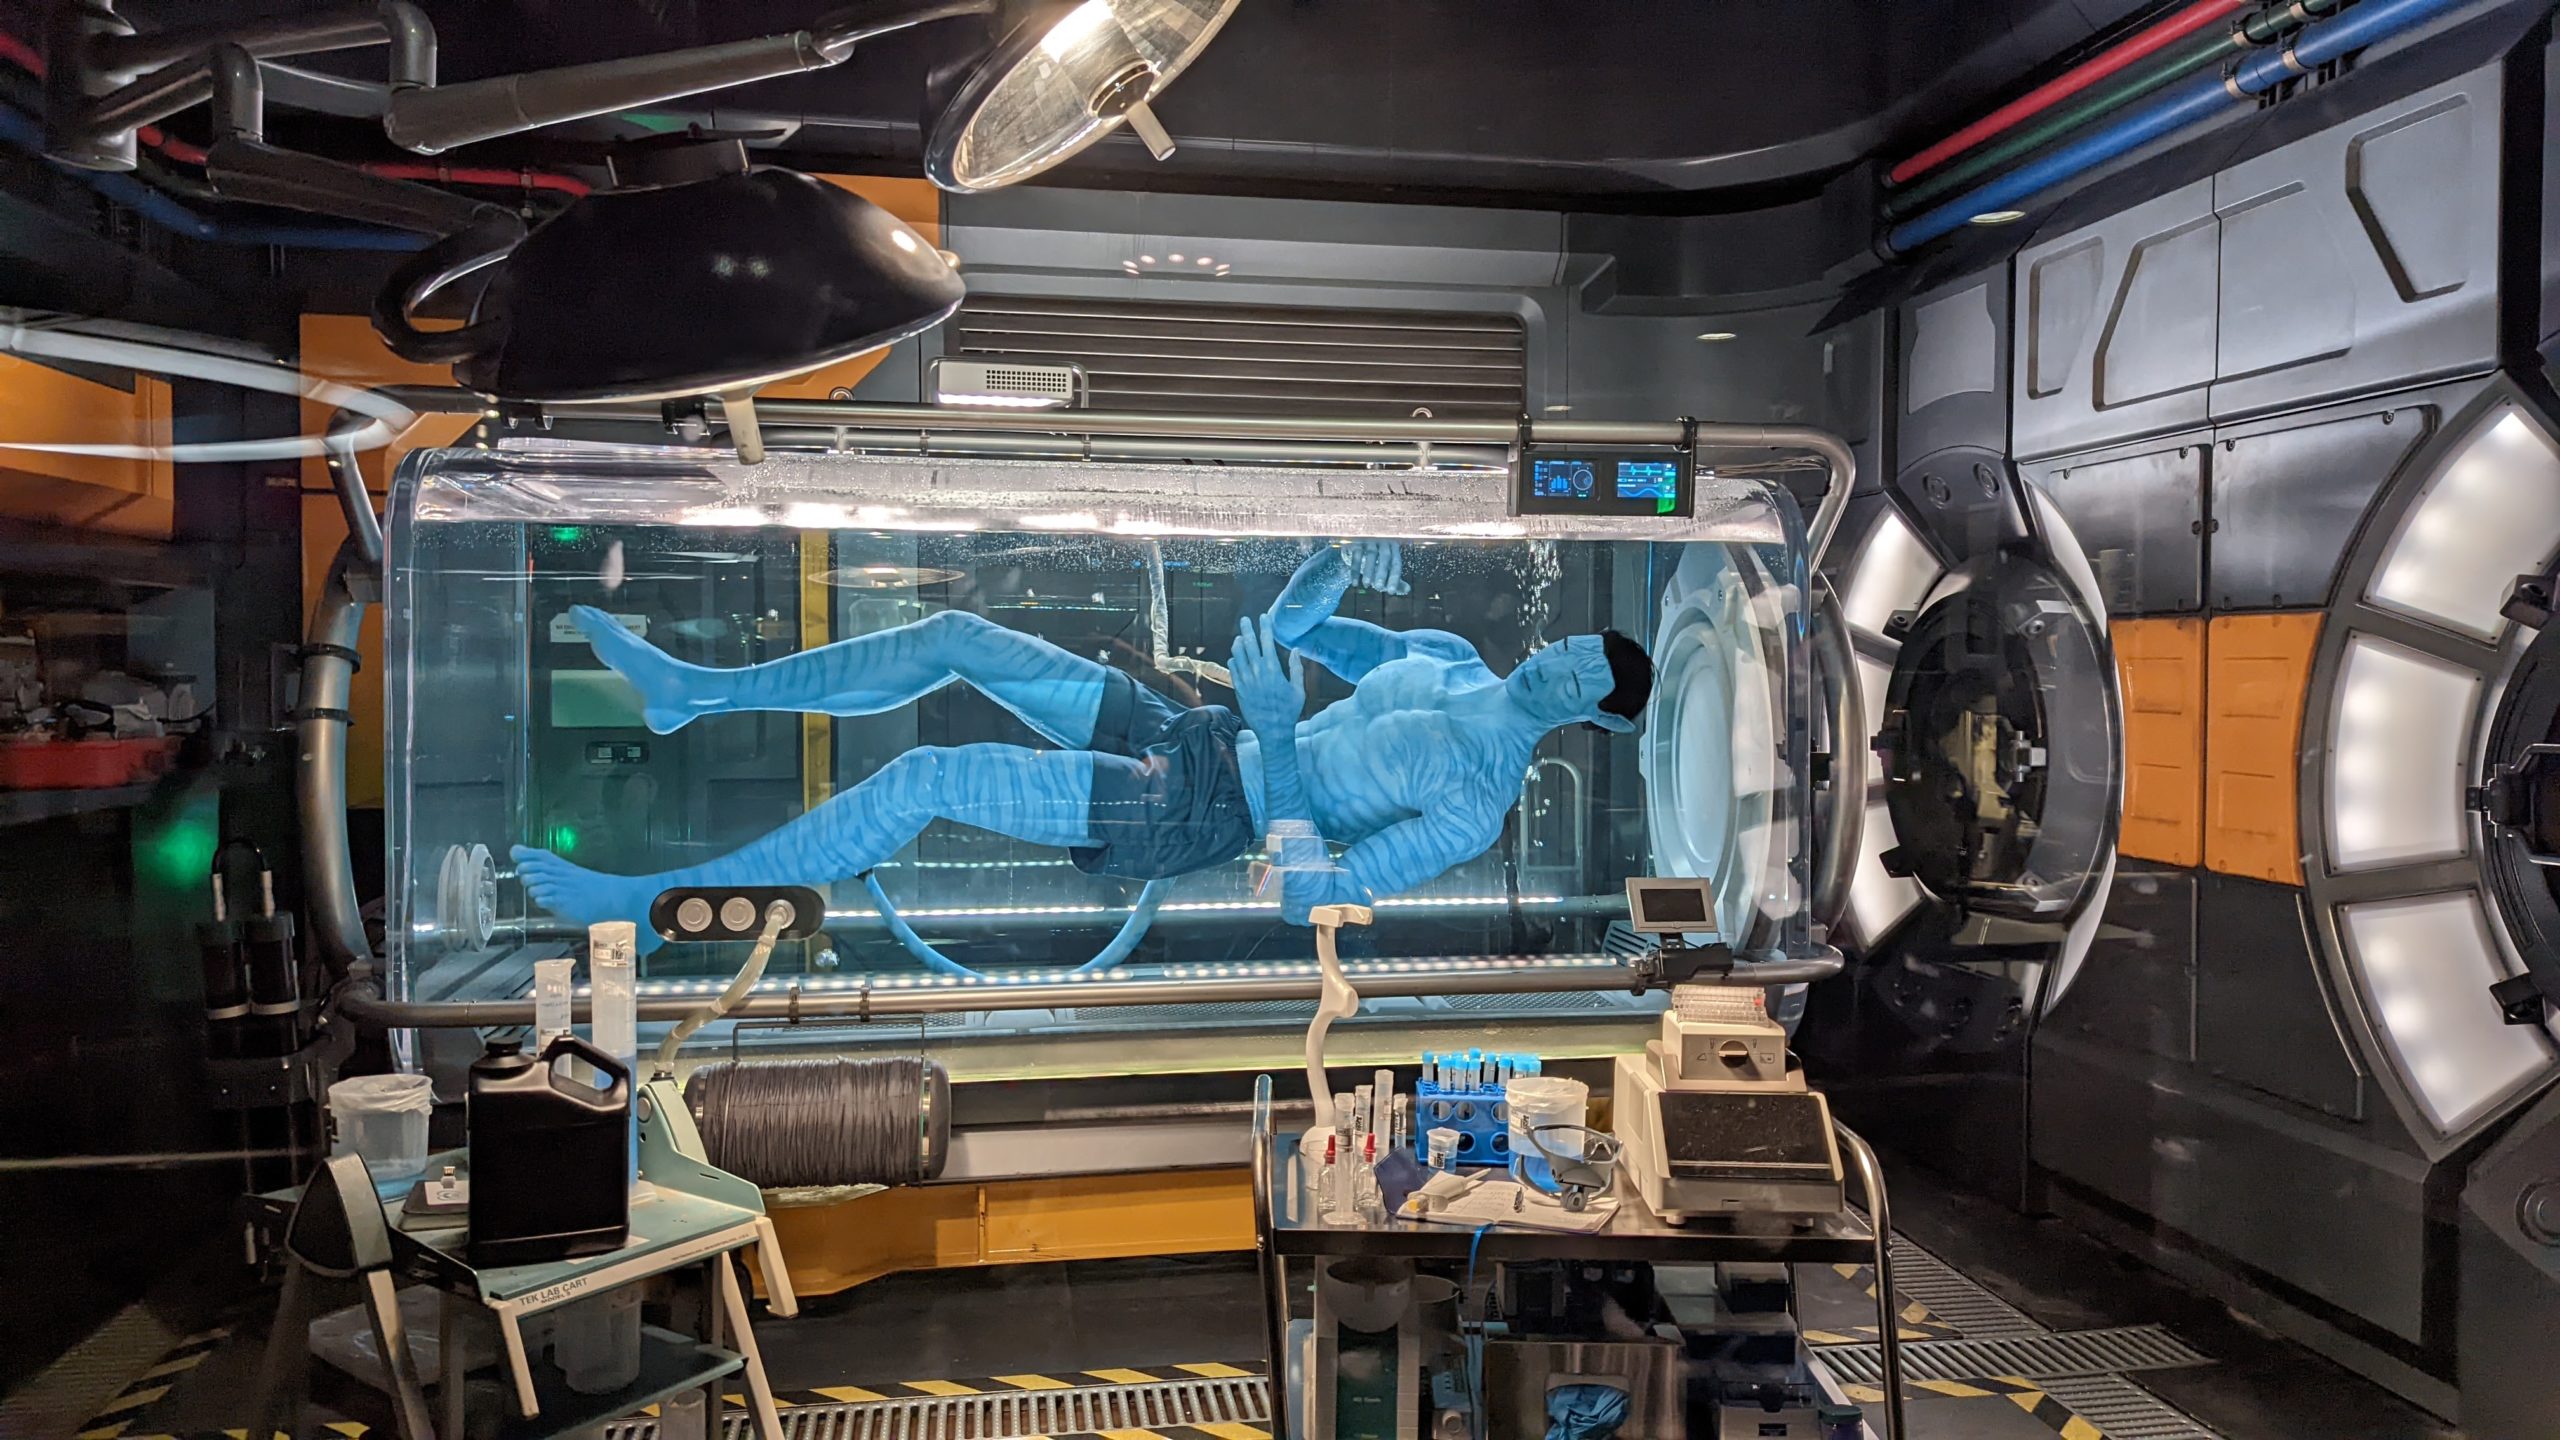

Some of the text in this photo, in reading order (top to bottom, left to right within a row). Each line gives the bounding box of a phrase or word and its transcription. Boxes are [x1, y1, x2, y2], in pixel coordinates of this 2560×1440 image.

[519, 1278, 588, 1305] TEK LAB CART
[541, 1294, 566, 1304] MODEL
